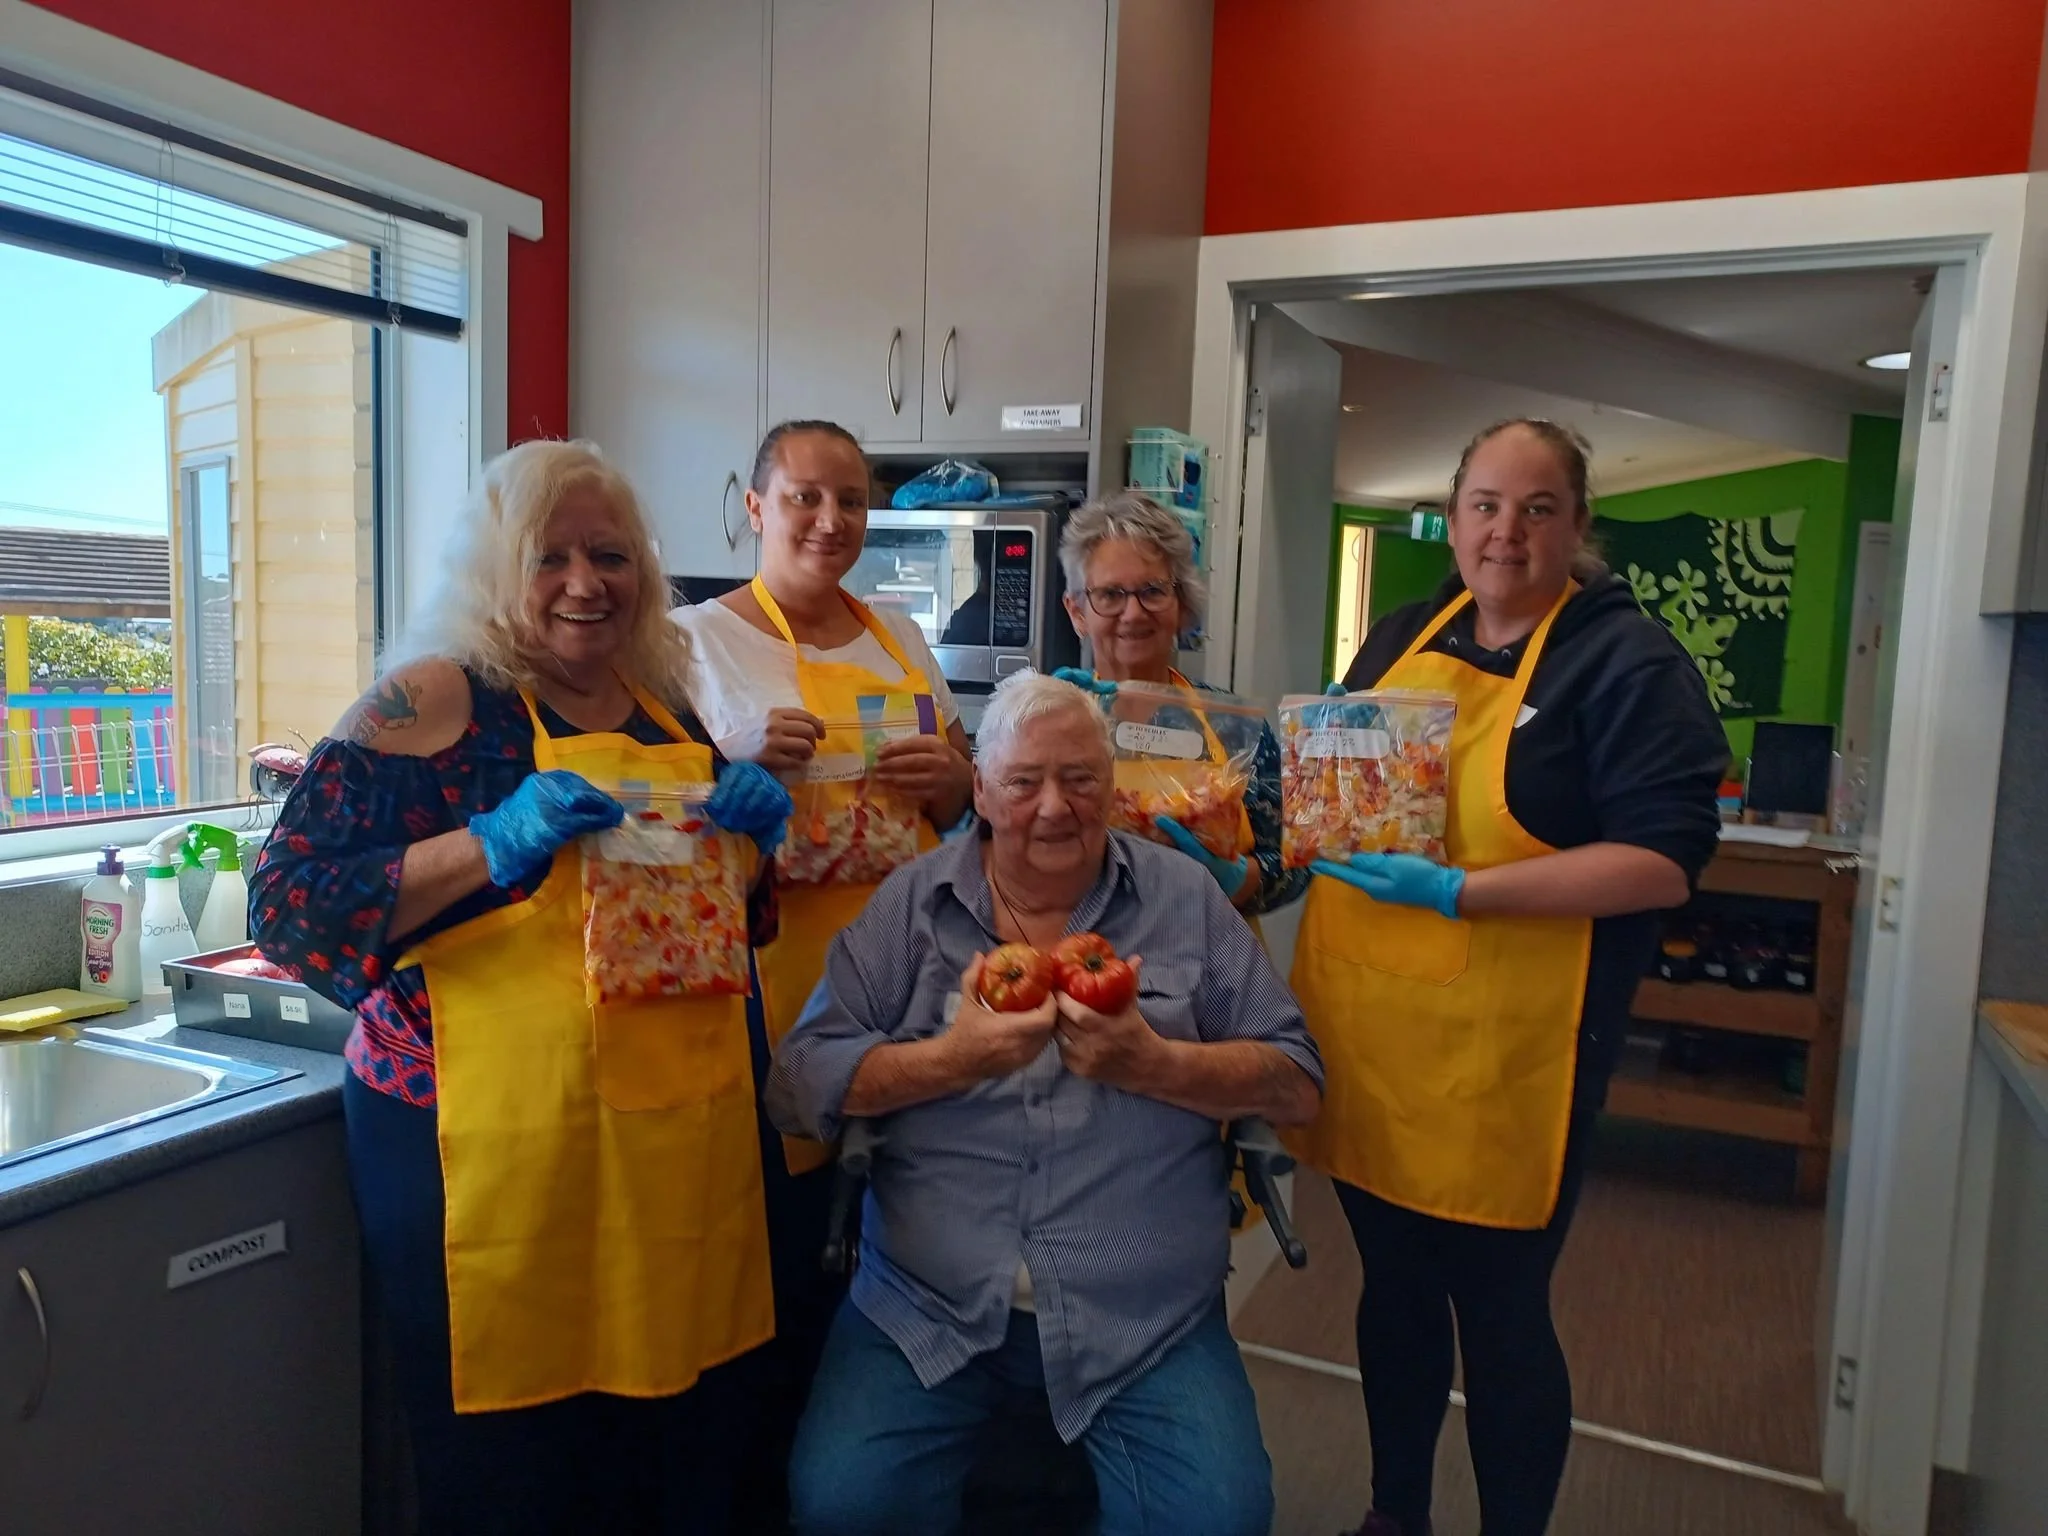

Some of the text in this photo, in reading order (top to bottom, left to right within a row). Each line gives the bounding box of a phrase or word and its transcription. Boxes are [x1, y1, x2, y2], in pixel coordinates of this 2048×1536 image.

[86, 915, 115, 928] MORNING
[89, 925, 109, 936] FRESH
[88, 948, 110, 958] EDITION
[187, 1233, 266, 1272] COMPOST
